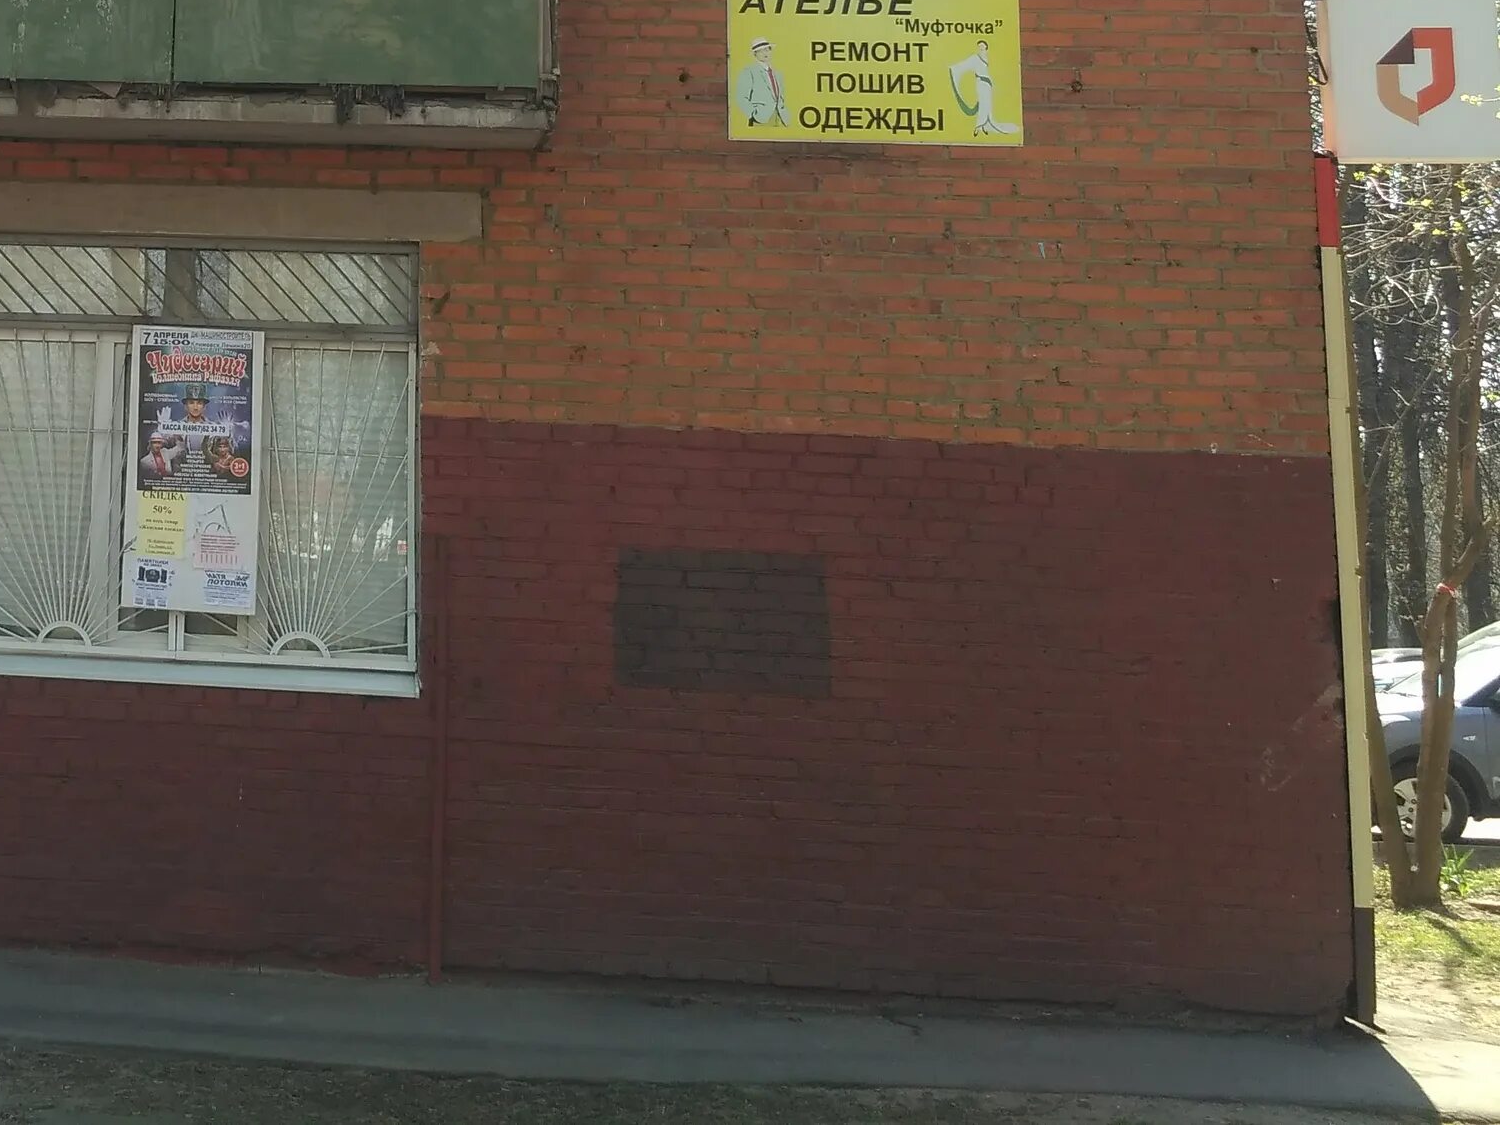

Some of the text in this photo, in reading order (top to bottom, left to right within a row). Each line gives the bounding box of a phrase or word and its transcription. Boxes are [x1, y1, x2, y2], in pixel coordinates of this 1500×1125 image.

[810, 41, 929, 63] РЕМОНТ
[816, 72, 925, 94] ПОШИВ
[799, 106, 944, 134] ОДЕЖДЫ
[143, 331, 188, 344] 7 АПРЕЛЯ
[153, 338, 190, 346] 15:00
[152, 504, 173, 515] 50%
